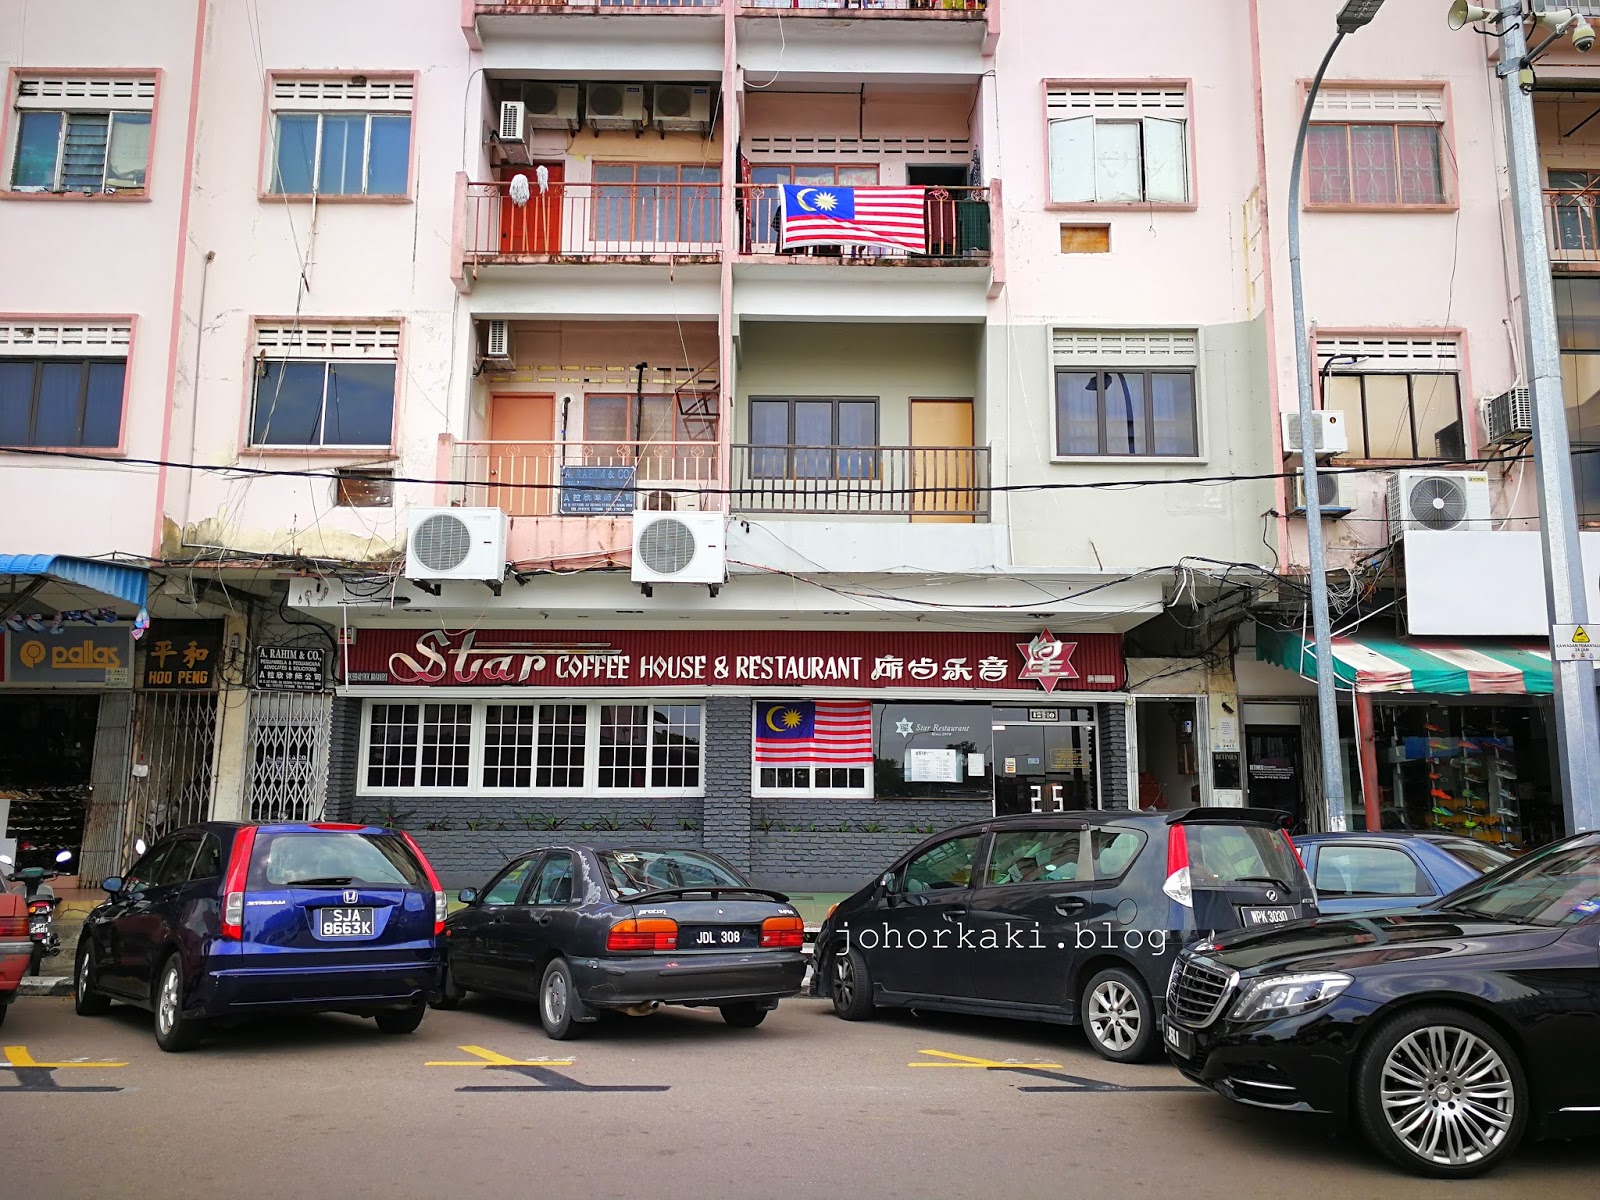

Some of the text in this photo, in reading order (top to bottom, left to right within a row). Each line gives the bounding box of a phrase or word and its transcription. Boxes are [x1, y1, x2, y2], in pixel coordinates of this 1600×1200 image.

[607, 470, 615, 479] &
[52, 640, 121, 669] pallas
[150, 640, 209, 669] 平和
[260, 648, 268, 658] A.
[270, 649, 297, 659] RAHIM
[299, 651, 305, 660] &
[388, 629, 863, 683] Star COFFEE HOUSE & RESTAURANT
[148, 670, 208, 684] HOO PENG
[915, 723, 970, 732] Star Restaurant
[333, 909, 361, 922] SJA
[1250, 910, 1288, 924] WPK 3030
[323, 921, 372, 935] 8663K
[696, 931, 741, 944] JDL 308
